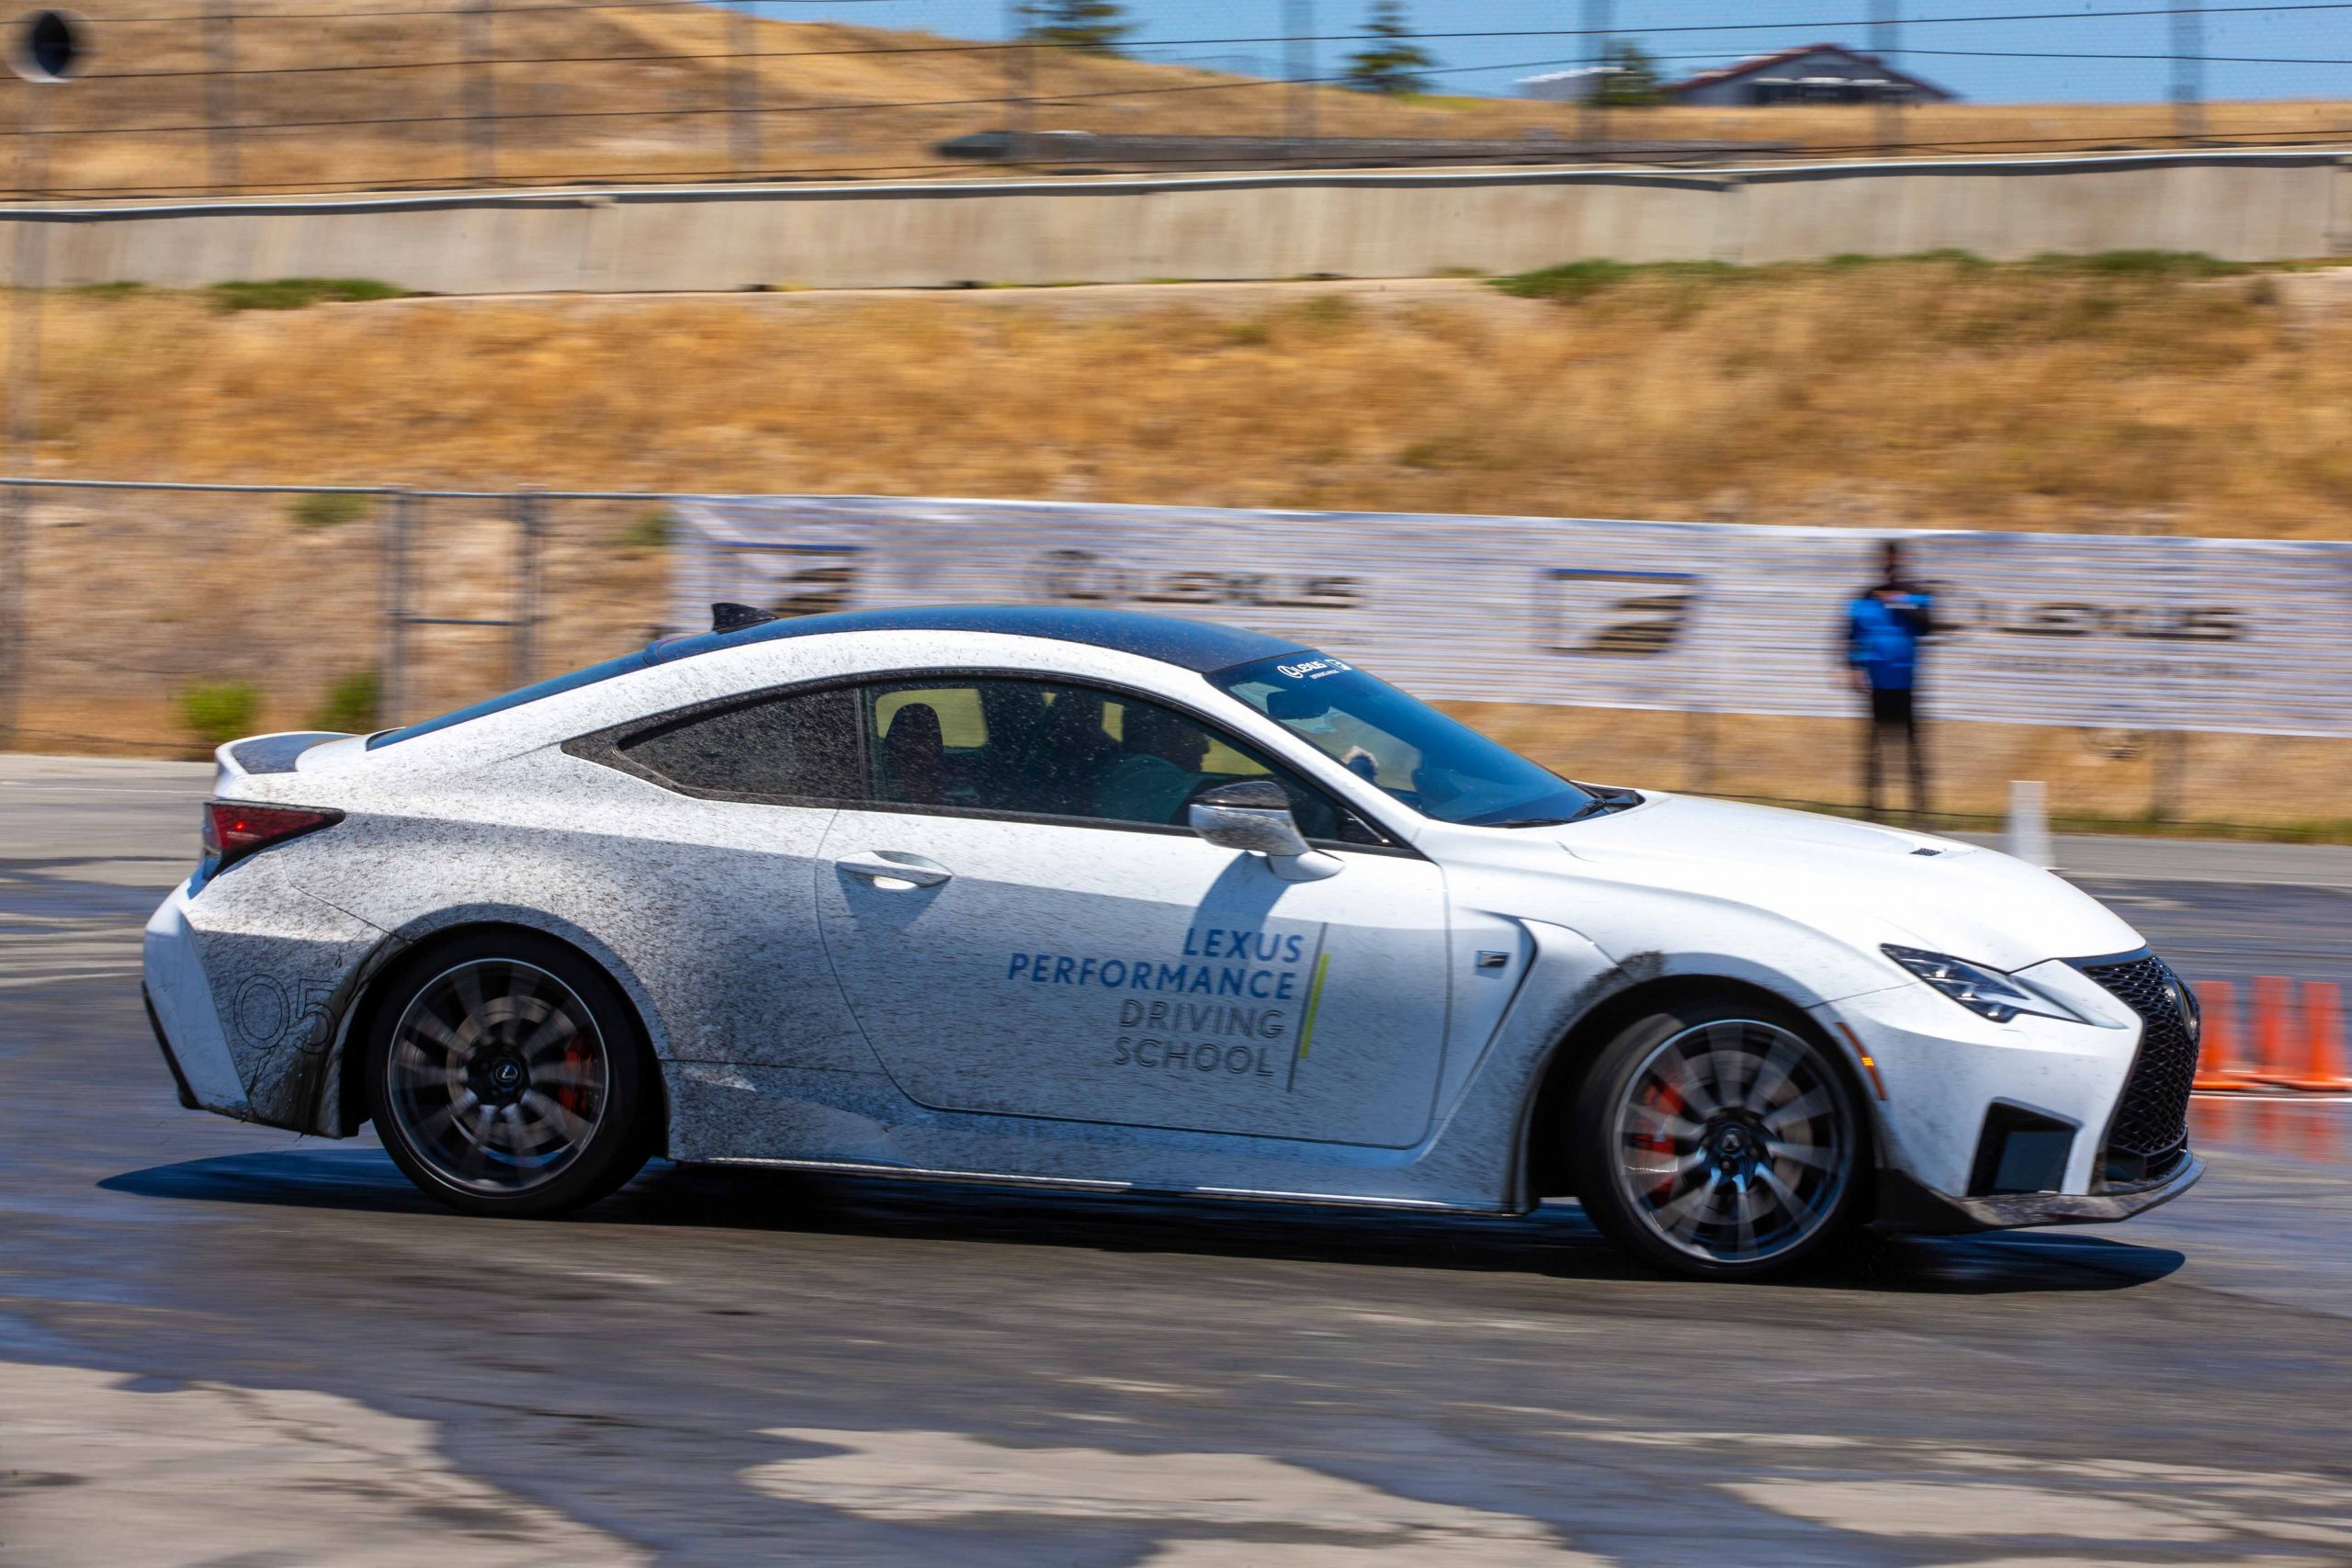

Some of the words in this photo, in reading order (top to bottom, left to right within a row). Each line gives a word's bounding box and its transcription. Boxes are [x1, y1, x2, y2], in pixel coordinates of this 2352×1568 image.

[1182, 927, 1305, 963] LEXUS
[1007, 953, 1297, 1000] PERFORMANCE
[232, 974, 338, 1055] 05
[1118, 998, 1286, 1039] DRIVING
[1113, 1036, 1278, 1077] SCHOOL
